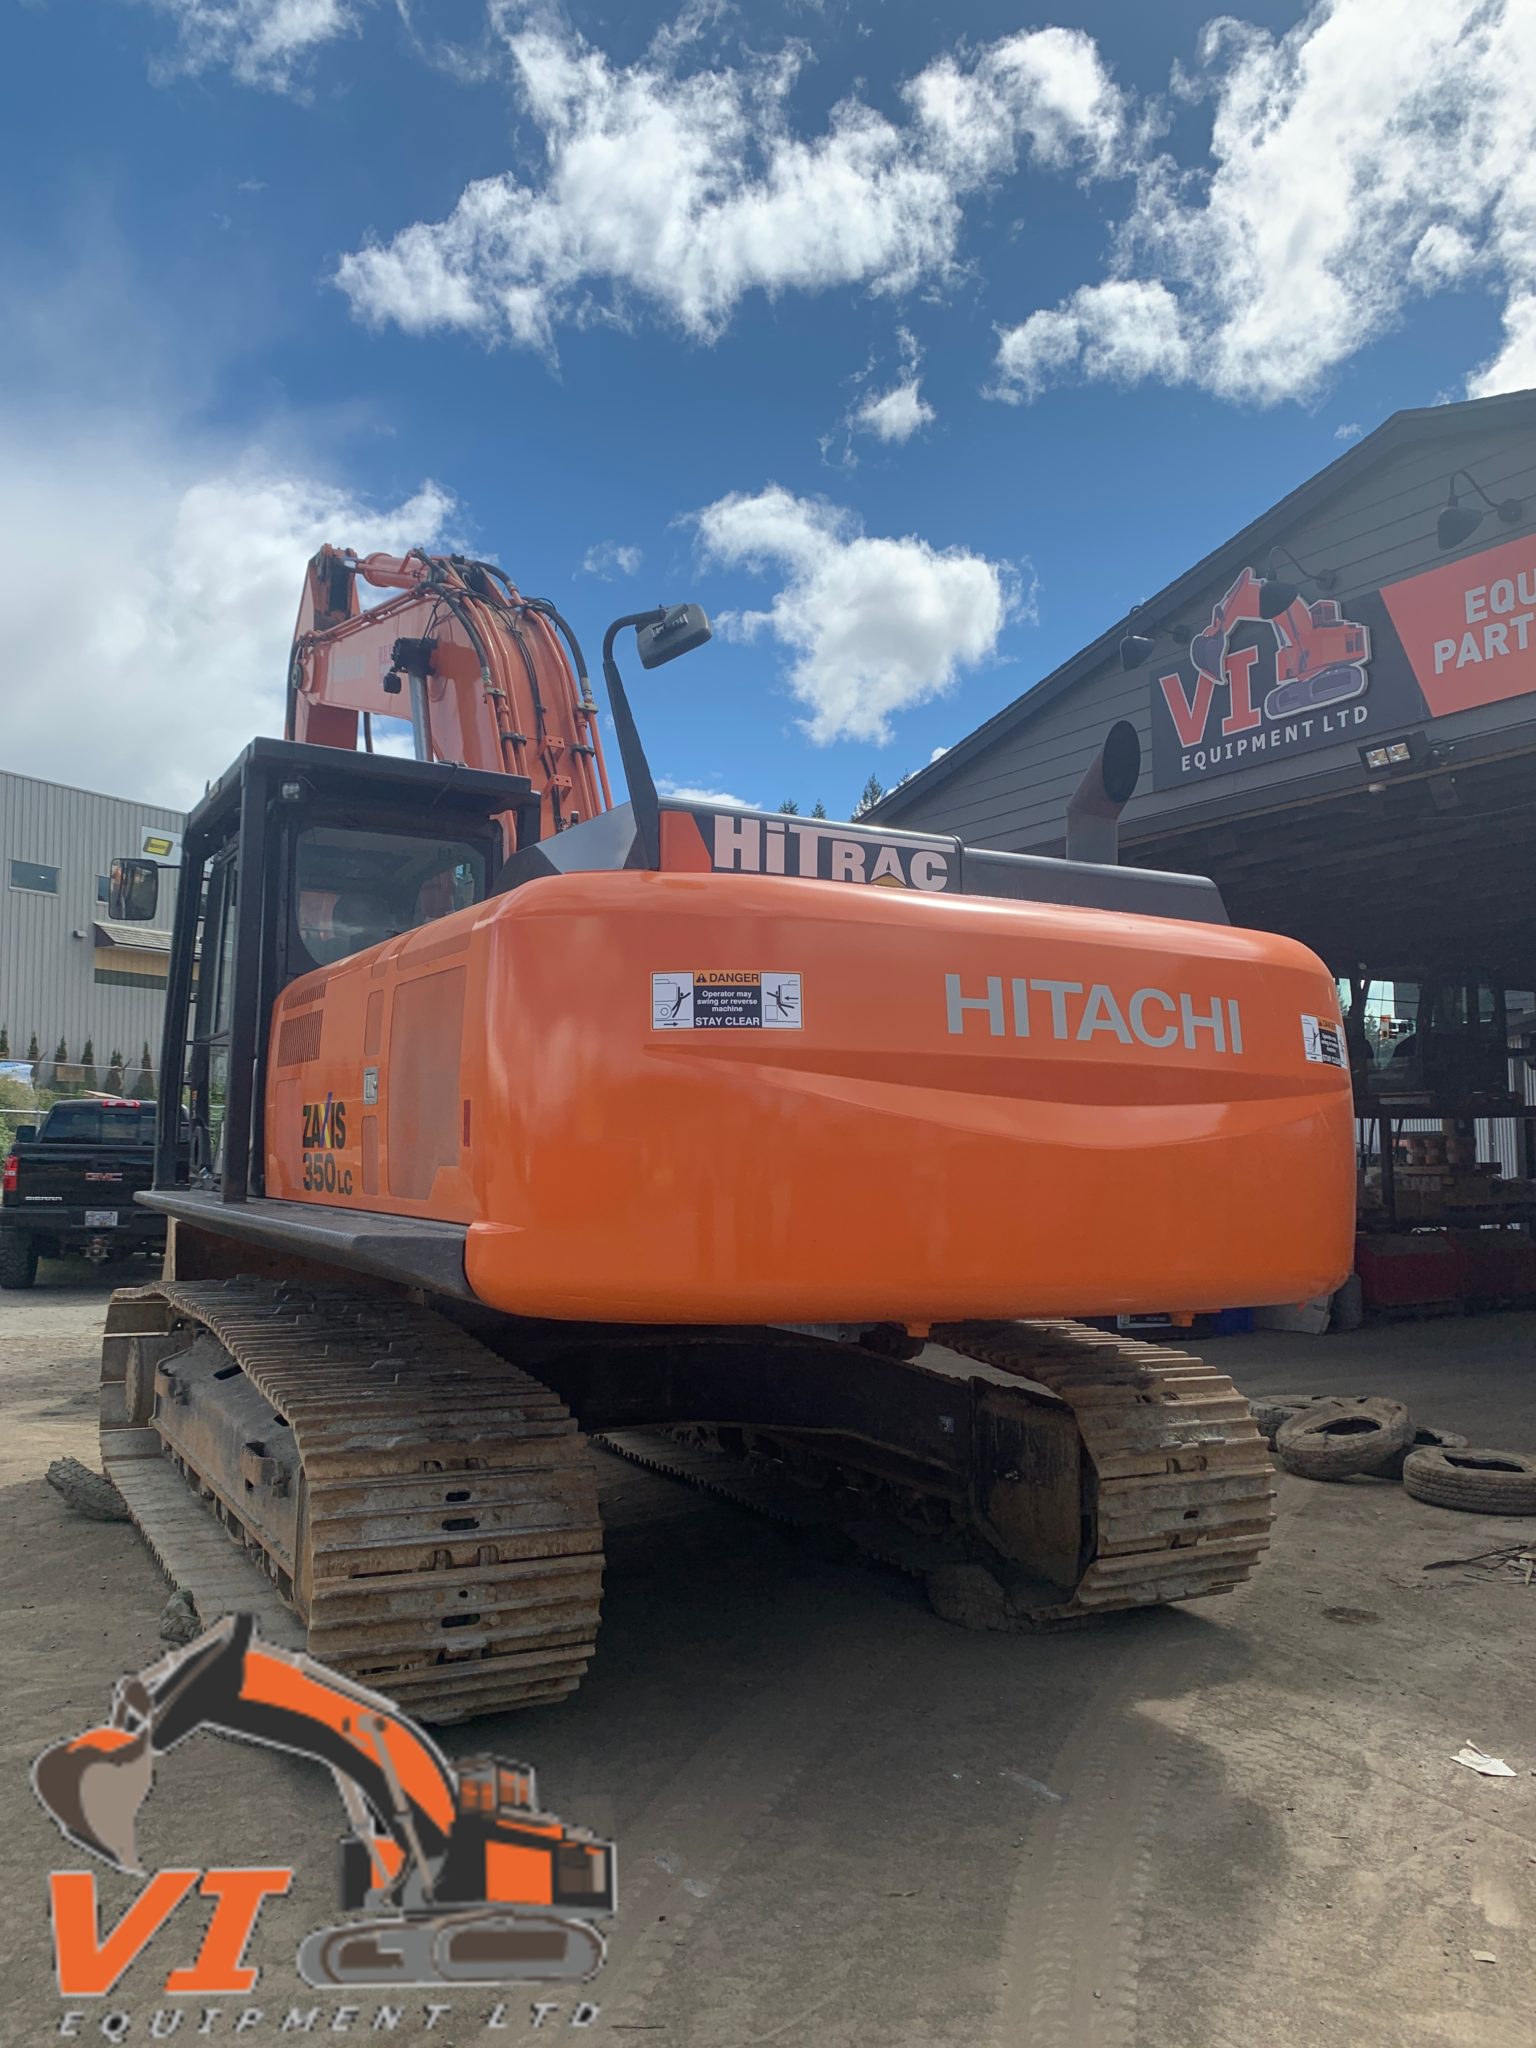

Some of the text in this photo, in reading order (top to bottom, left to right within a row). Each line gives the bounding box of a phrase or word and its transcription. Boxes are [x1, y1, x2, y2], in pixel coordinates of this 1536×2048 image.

[1434, 612, 1534, 674] PART
[1159, 644, 1262, 748] VI
[1181, 704, 1370, 772] EQUIPMENT LTD
[697, 998, 719, 1006] swing
[702, 990, 735, 998] Operator
[709, 973, 759, 983] DANGER
[695, 1017, 760, 1026] STAY CLEAR
[944, 973, 1243, 1054] HITACHI
[302, 1092, 346, 1149] ZAXIS
